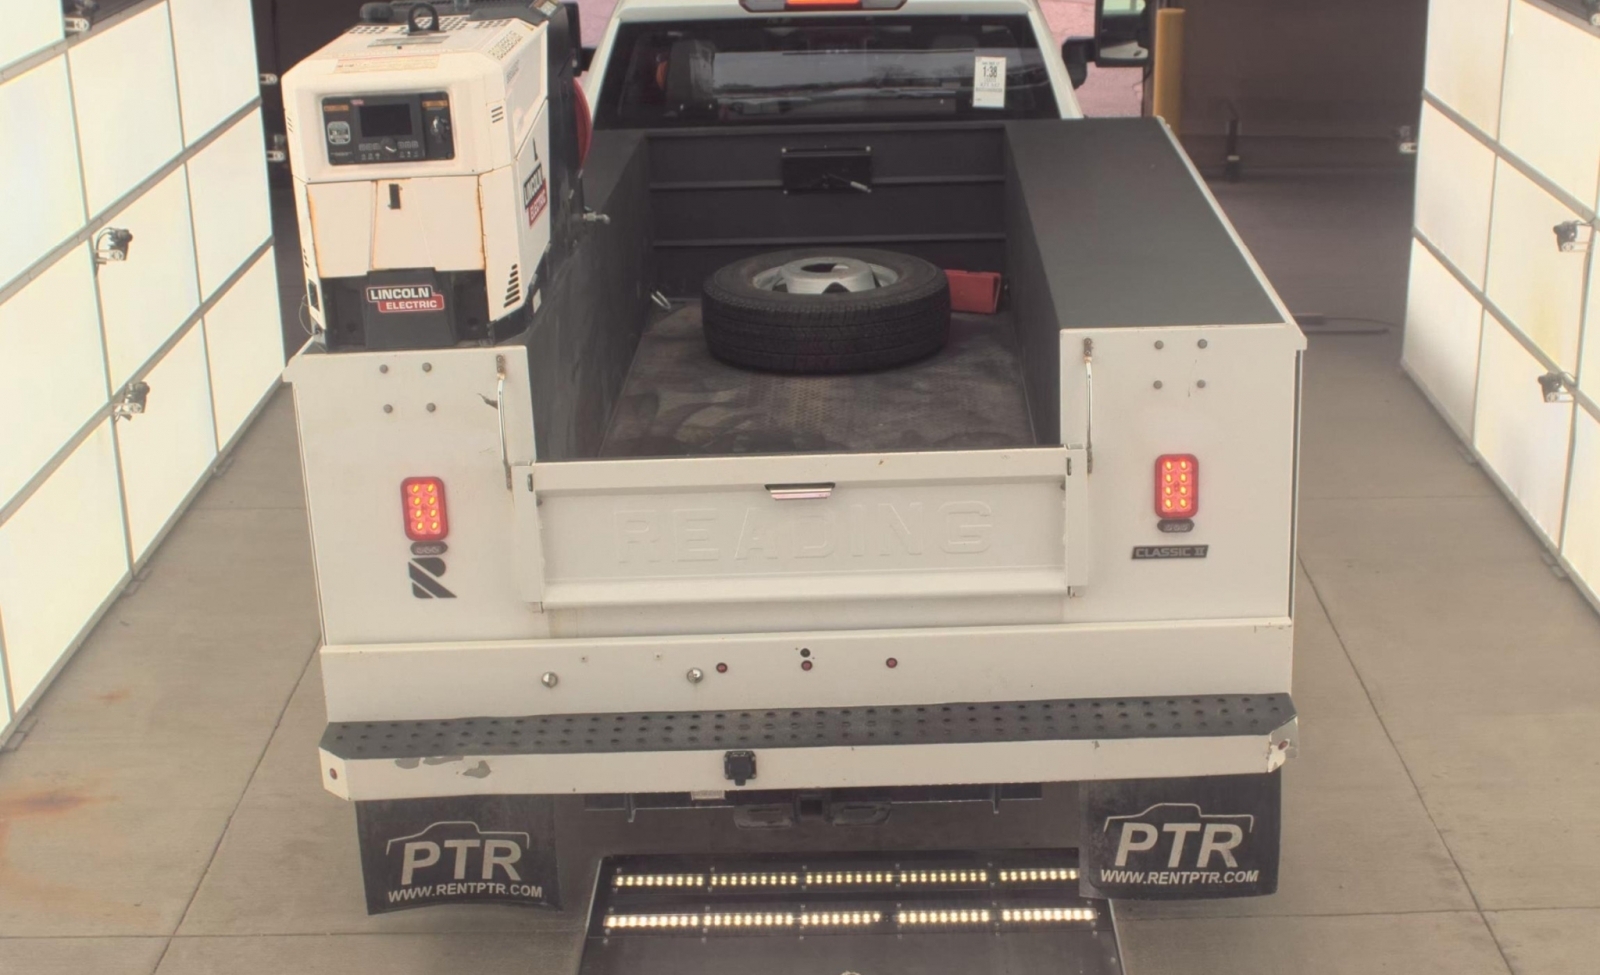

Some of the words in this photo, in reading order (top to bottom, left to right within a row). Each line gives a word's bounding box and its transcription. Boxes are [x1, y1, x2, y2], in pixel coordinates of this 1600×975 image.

[370, 287, 430, 301] LINCOLN
[385, 300, 438, 310] ELECTRIC
[614, 501, 993, 563] READING
[1135, 547, 1191, 558] CLASSIC
[1114, 822, 1243, 868] PTR
[401, 839, 522, 886] PTR
[1100, 869, 1259, 885] WWW.RENTPTR.COM
[388, 882, 543, 903] WWW.RENTPTR.COM
